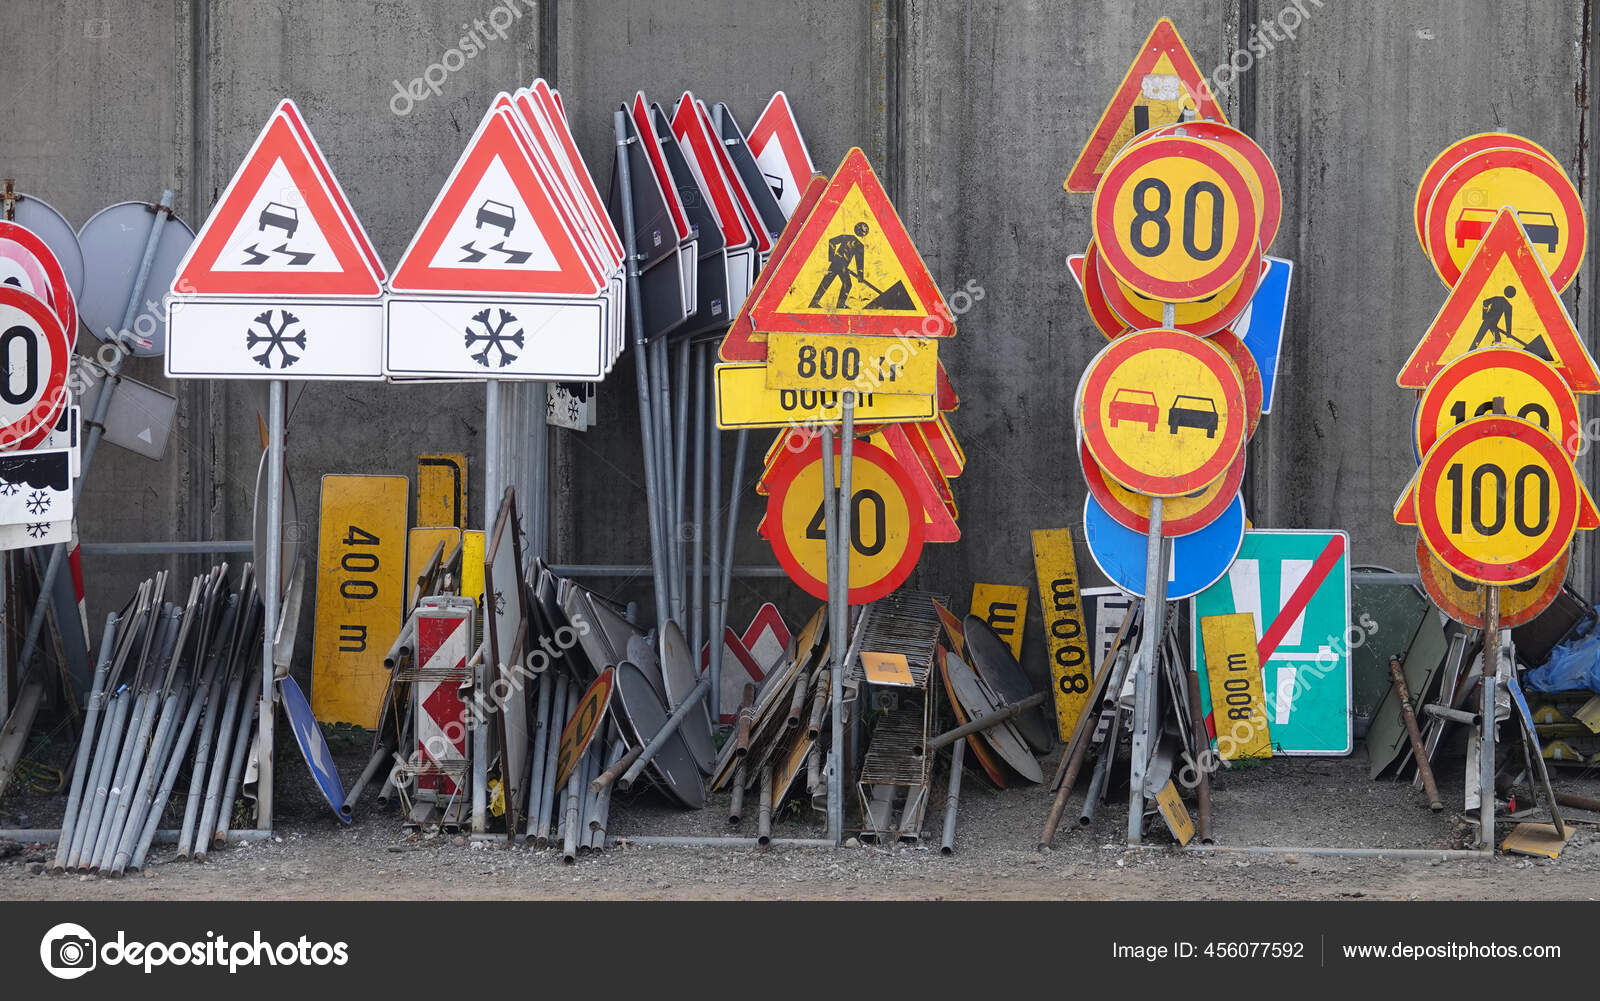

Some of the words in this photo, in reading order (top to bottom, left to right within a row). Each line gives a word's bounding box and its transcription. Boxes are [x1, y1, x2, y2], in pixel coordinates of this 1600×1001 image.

[1130, 178, 1225, 261] 80
[797, 345, 861, 381] 800
[806, 487, 886, 557] 40
[1447, 463, 1550, 537] 100
[340, 525, 380, 600] 400
[339, 624, 367, 652] m
[1227, 653, 1247, 672] m
[1224, 678, 1254, 720] 800
